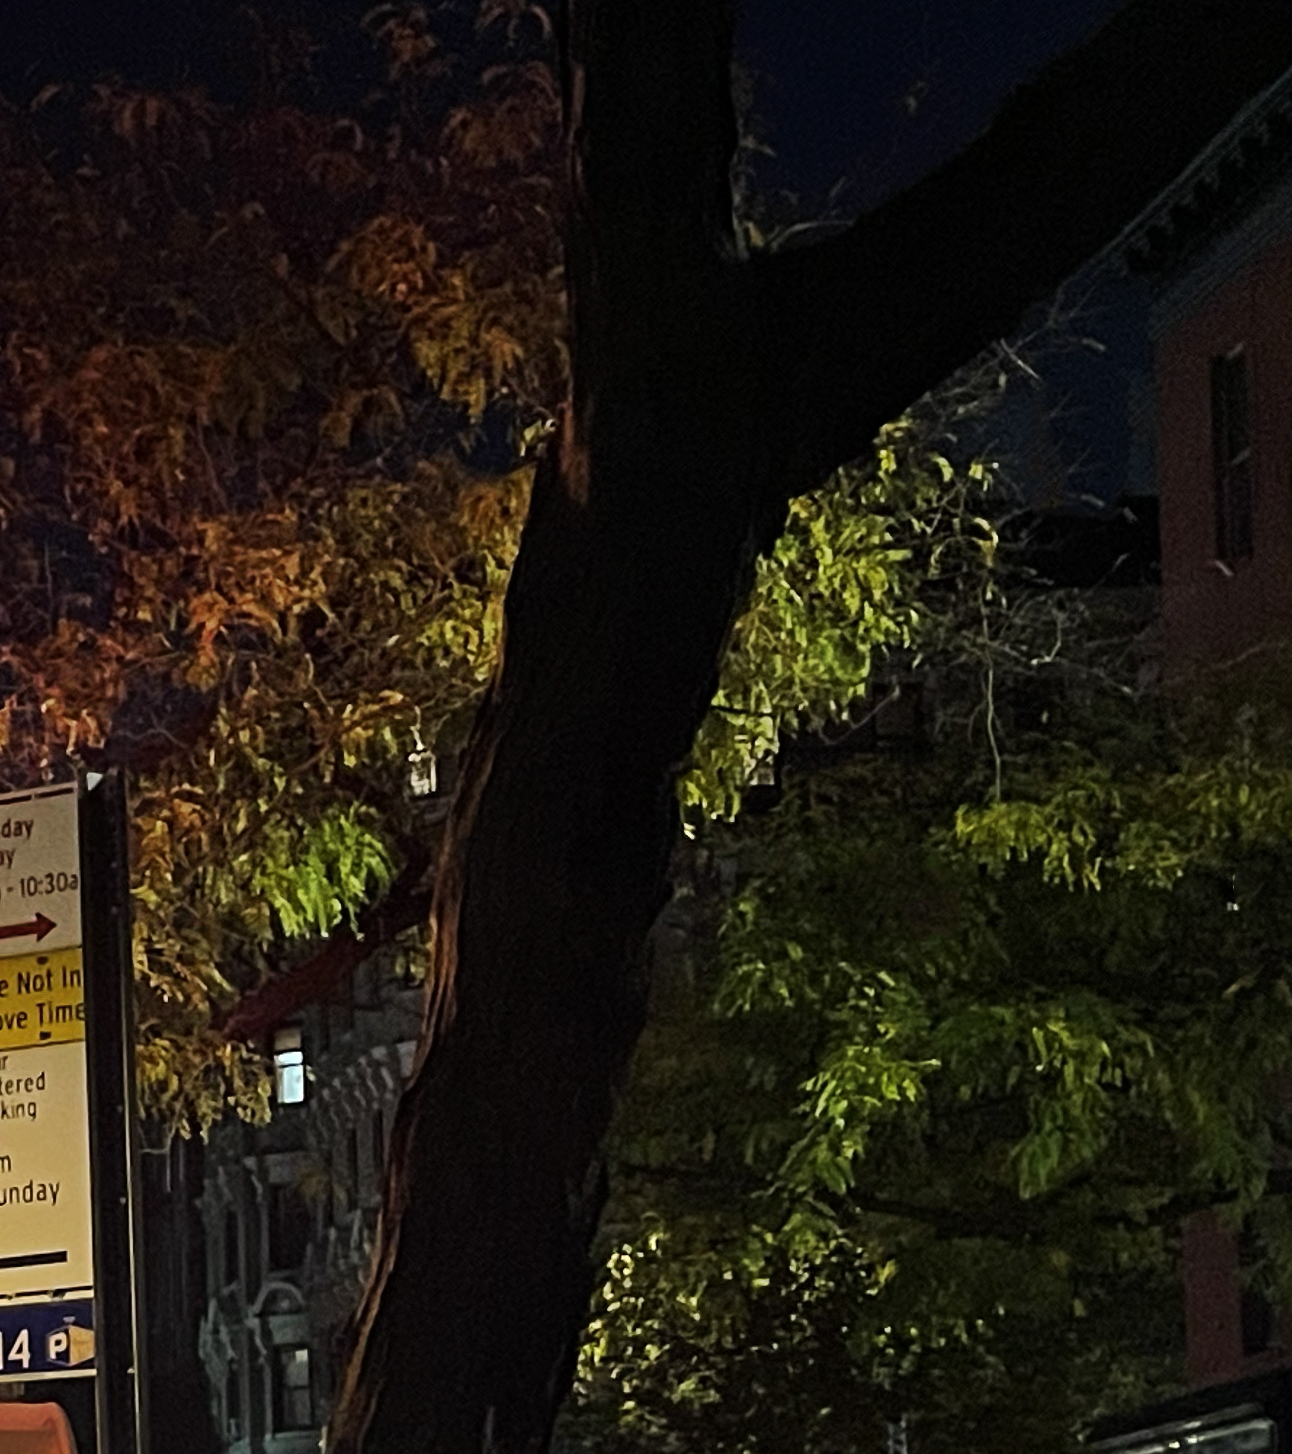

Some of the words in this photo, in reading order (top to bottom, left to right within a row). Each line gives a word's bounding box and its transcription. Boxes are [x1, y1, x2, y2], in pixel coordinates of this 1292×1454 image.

[19, 873, 79, 899] 10:30a
[17, 970, 53, 995] Not
[62, 966, 82, 987] In
